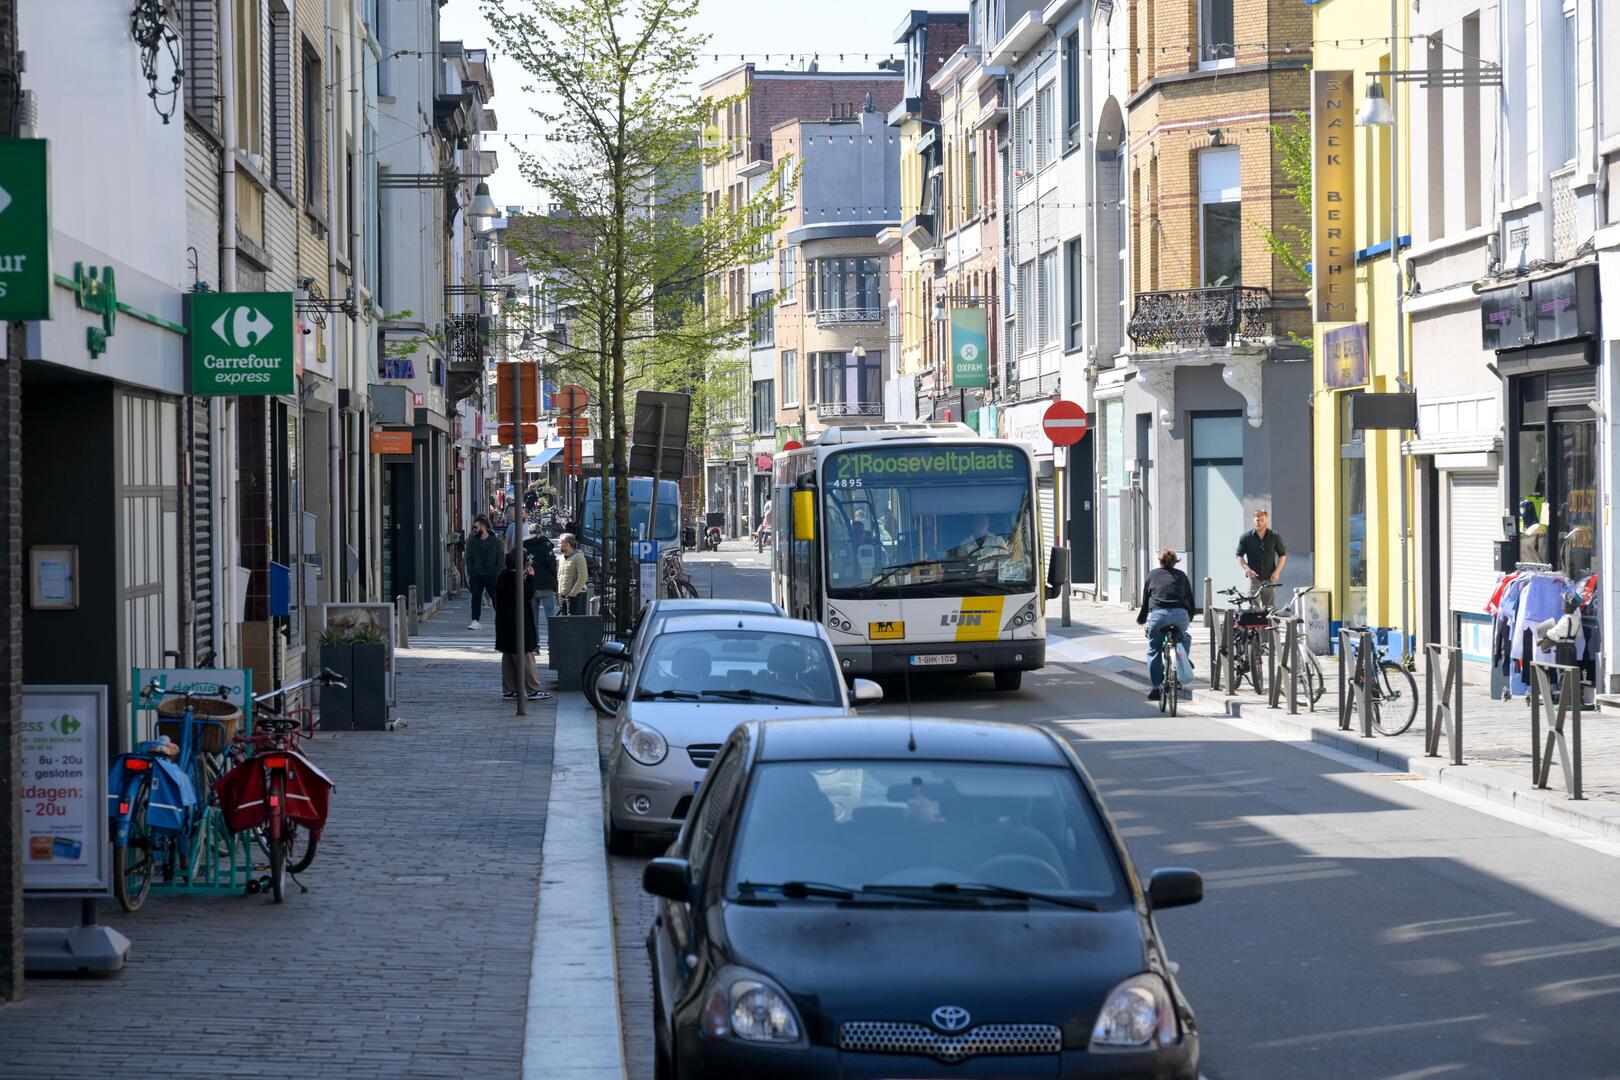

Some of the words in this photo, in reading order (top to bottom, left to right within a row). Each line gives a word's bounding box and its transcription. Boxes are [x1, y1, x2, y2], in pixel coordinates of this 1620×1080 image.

[1325, 79, 1343, 166] SNACK
[1324, 191, 1346, 313] BERCHEM
[203, 353, 282, 369] Carrefour
[956, 363, 984, 372] OXFAM
[214, 372, 271, 386] express
[836, 453, 860, 479] 21
[859, 449, 1014, 475] Rooseveltplaats
[833, 479, 863, 488] 4895
[640, 542, 653, 560] P
[39, 755, 53, 765] 8u
[62, 755, 83, 765] 20u
[35, 769, 83, 780] gesloten
[36, 802, 67, 816] 20u
